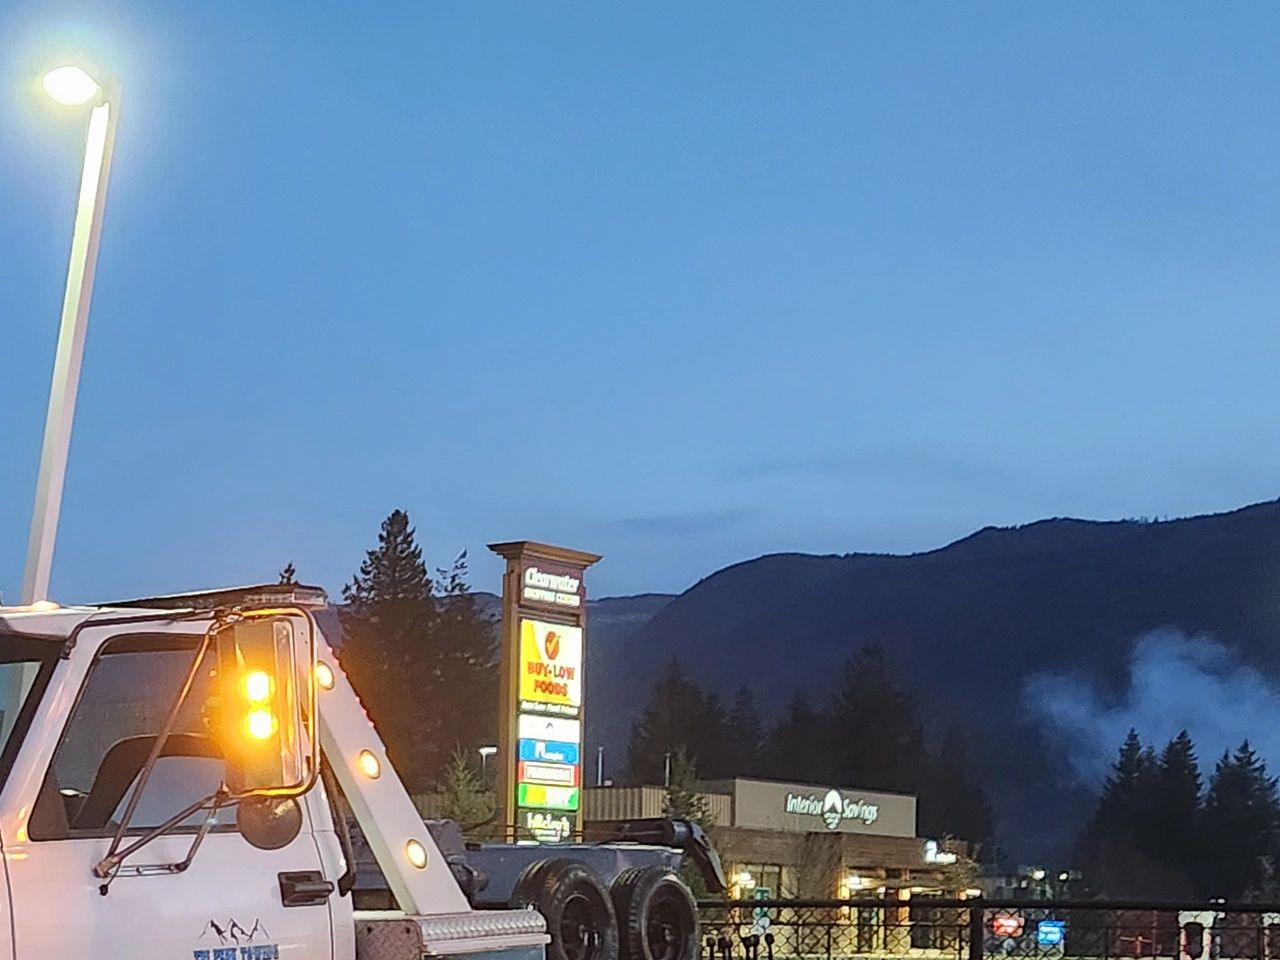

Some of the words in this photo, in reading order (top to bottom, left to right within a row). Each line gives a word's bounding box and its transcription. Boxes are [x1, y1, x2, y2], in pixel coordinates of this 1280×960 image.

[534, 679, 568, 697] FOODS
[786, 793, 823, 814] Interior
[842, 799, 878, 825] Savings
